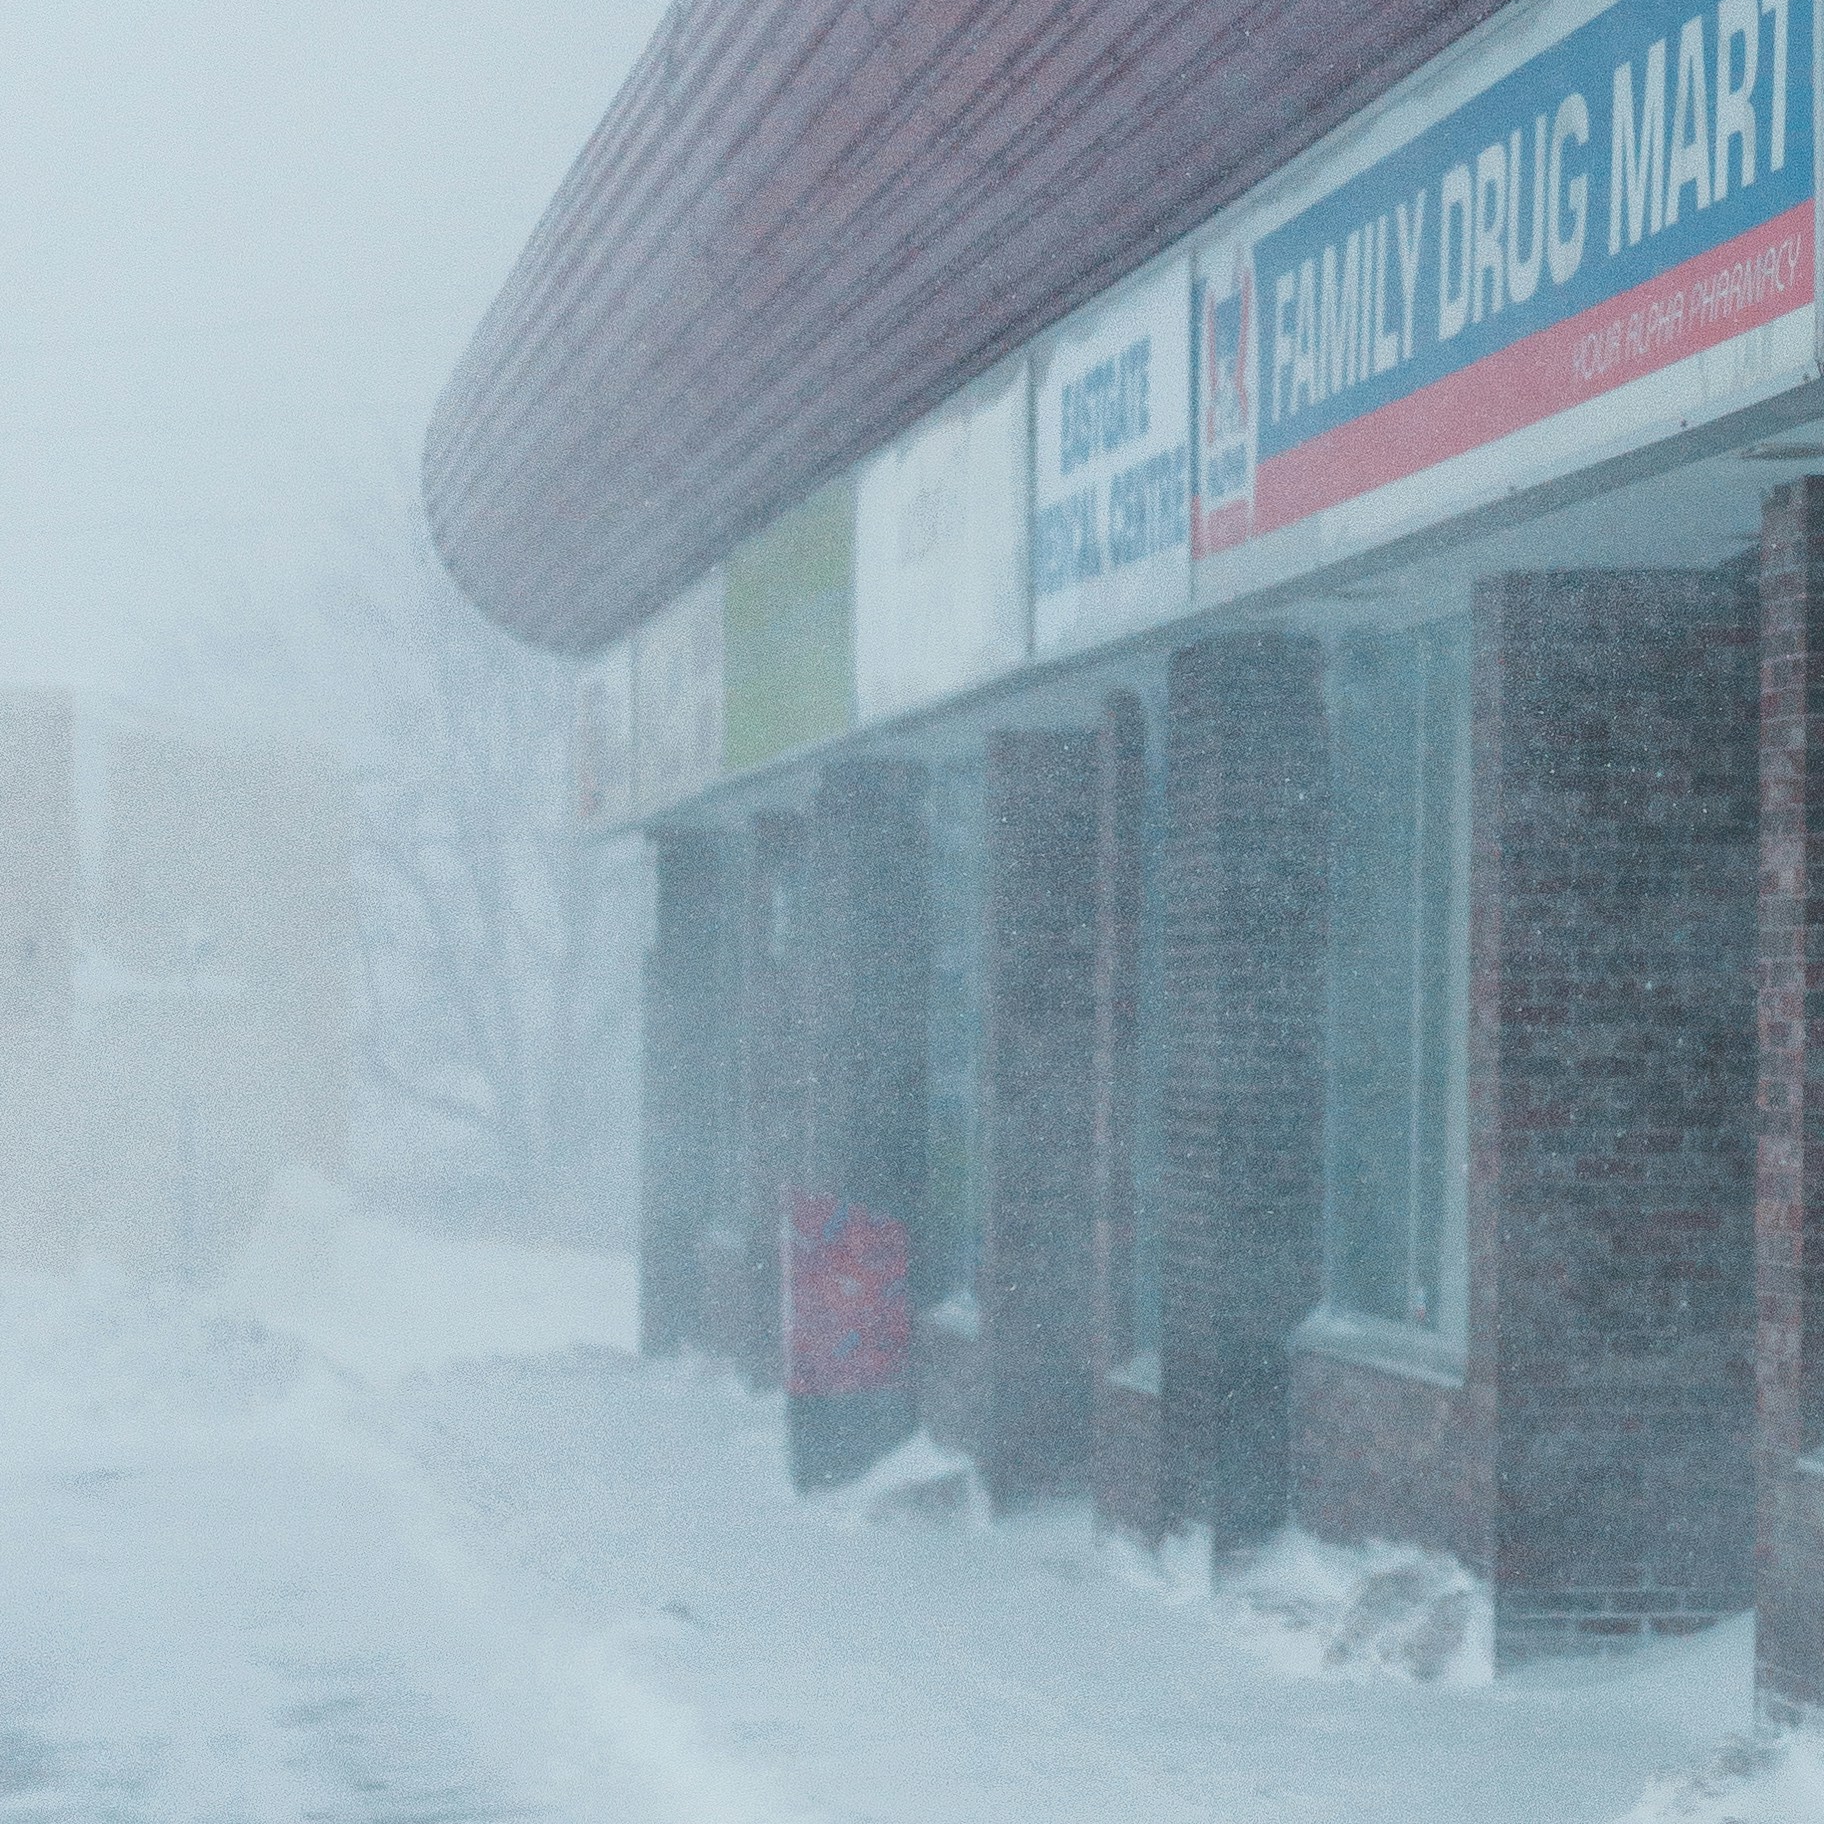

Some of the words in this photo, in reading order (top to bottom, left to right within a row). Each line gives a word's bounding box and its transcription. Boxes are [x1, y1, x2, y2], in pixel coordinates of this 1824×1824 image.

[1272, 188, 1427, 423] FAMILY
[1438, 93, 1589, 342] DRUG
[1687, 233, 1802, 332] PHARMACY
